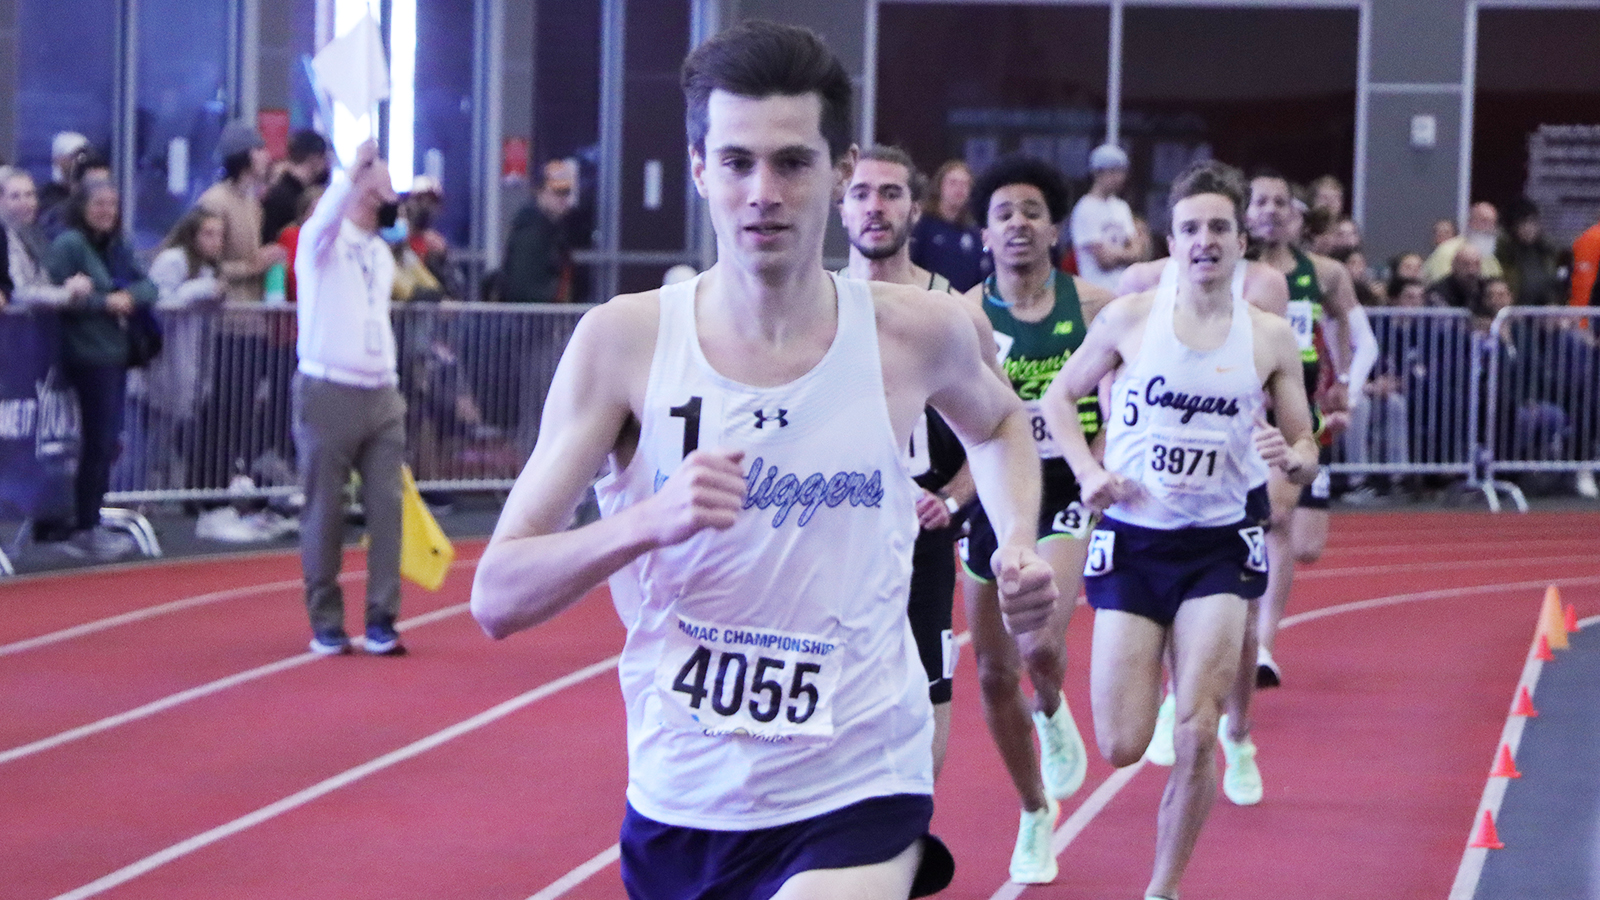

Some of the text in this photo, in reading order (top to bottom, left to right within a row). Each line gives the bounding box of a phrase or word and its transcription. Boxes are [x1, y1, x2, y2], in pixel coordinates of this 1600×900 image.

[1123, 389, 1138, 426] 5
[1145, 375, 1239, 424] Cougars
[669, 396, 703, 460] 1
[1152, 444, 1217, 477] 3971
[1091, 535, 1106, 572] 5
[678, 619, 719, 642] RMAC
[671, 645, 822, 724] 4055
